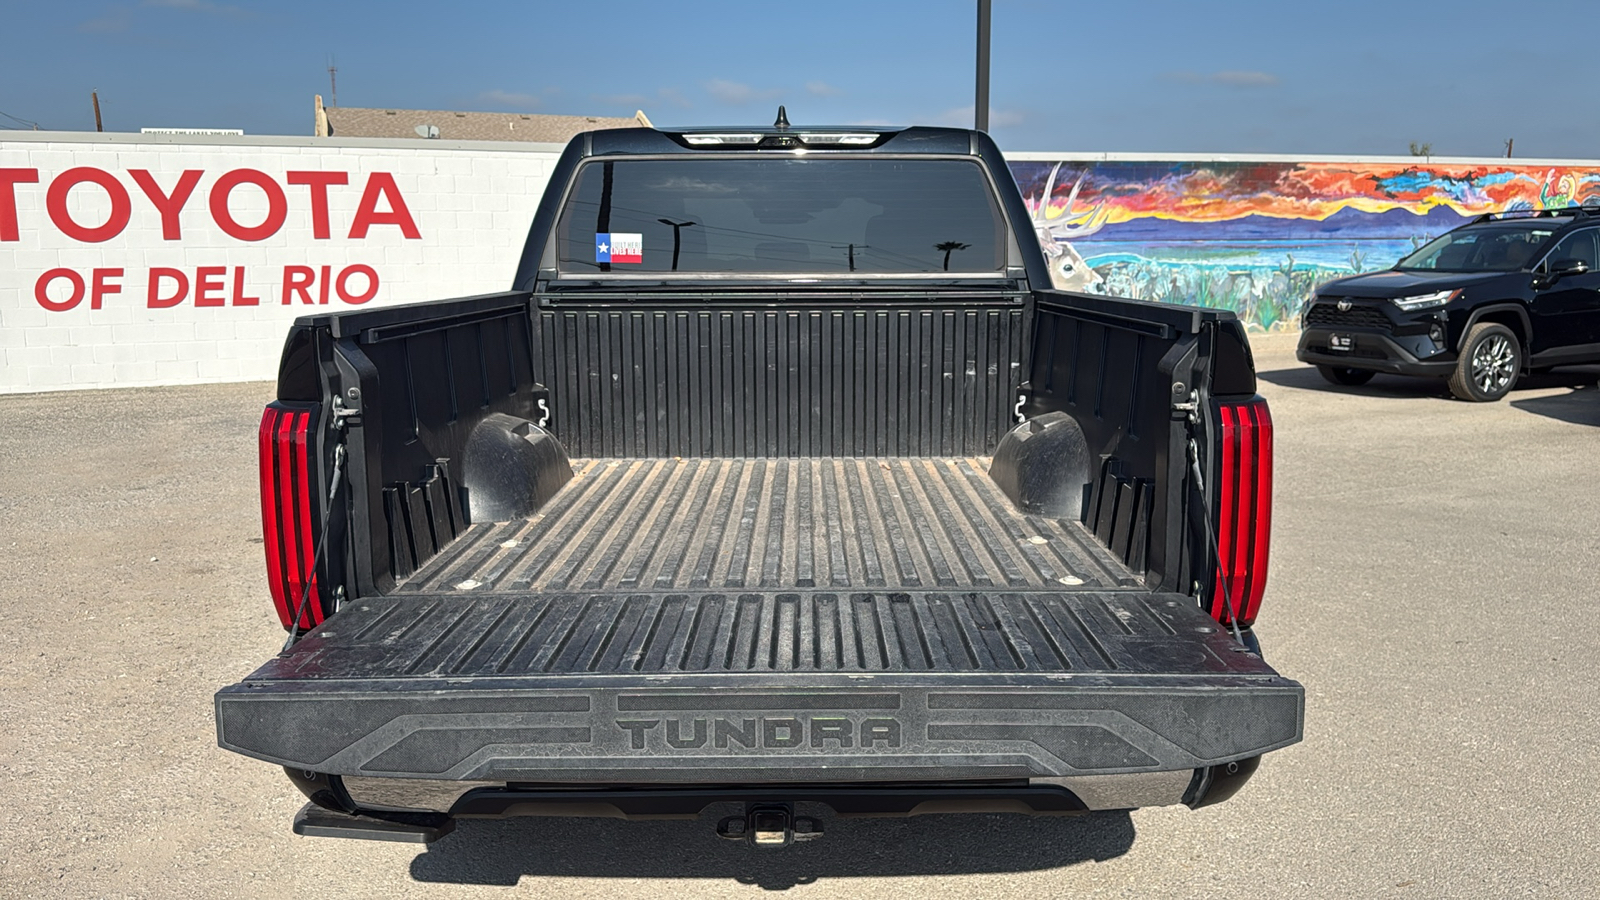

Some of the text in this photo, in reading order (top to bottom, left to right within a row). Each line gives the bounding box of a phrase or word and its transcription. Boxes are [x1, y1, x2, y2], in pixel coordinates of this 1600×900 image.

[0, 167, 422, 243] TOYOTA
[35, 264, 380, 312] OF DEL RIO
[616, 717, 900, 749] TUNDRA
